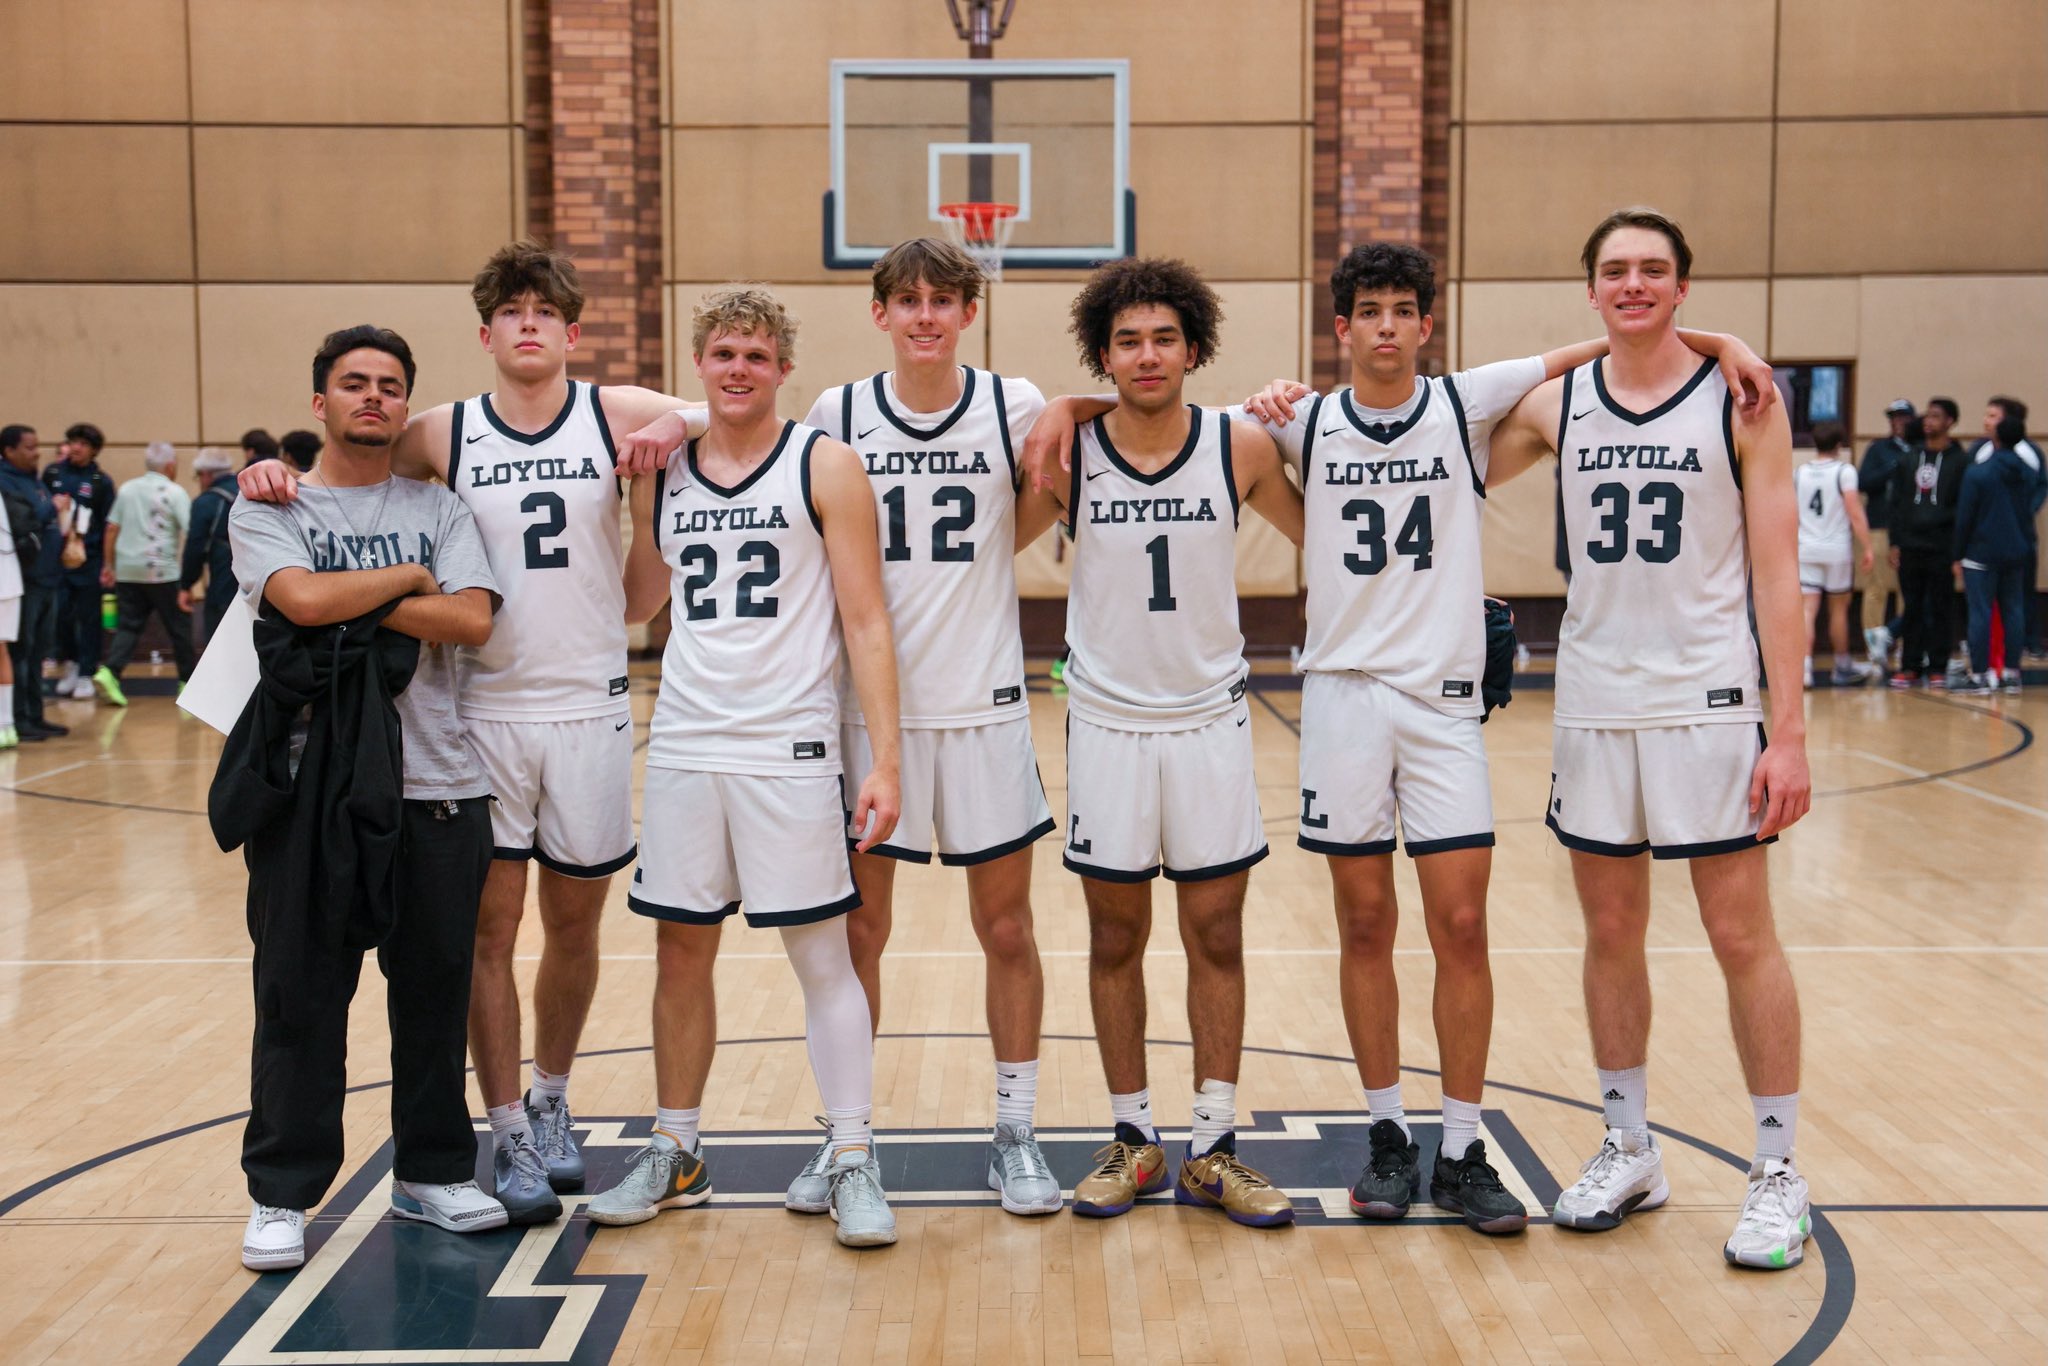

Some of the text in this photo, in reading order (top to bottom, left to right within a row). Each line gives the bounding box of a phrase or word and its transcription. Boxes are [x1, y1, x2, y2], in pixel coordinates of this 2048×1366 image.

[471, 457, 599, 488] LOYOLA
[865, 451, 991, 475] LOYOLA
[1325, 456, 1449, 485] LOYOLA
[1578, 445, 1702, 472] LOYOLA
[673, 505, 789, 534] LOYOLA
[1090, 498, 1217, 524] LOYOLA
[1586, 481, 1684, 564] 33
[1809, 488, 1823, 516] 4
[520, 491, 569, 569] 2
[882, 485, 975, 562] 12
[1341, 495, 1434, 575] 34
[680, 540, 780, 621] 22
[1145, 534, 1176, 611] 1
[1301, 788, 1328, 829] L
[1068, 813, 1091, 855] L
